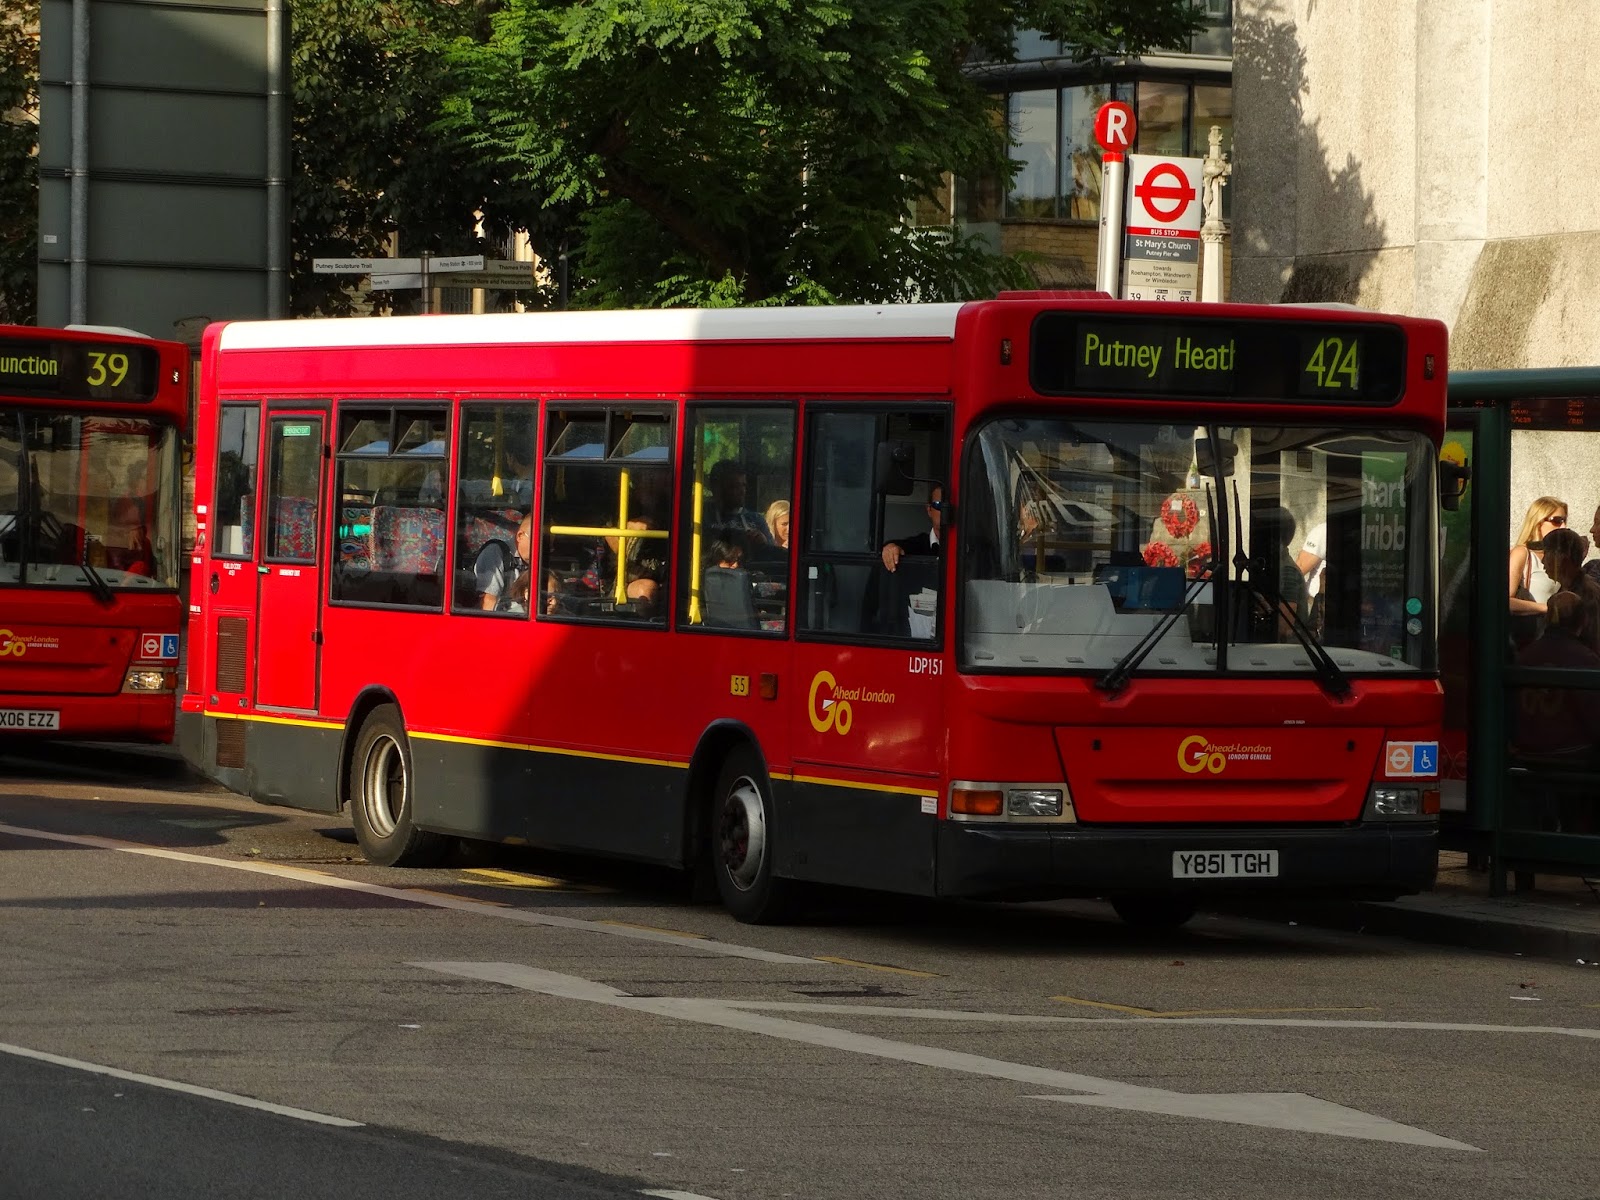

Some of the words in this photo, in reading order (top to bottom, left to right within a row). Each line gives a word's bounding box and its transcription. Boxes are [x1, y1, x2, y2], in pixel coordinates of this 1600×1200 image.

[1106, 107, 1128, 145] R
[1164, 229, 1180, 237] STOP
[1135, 239, 1143, 247] St
[1144, 239, 1167, 250] Mary's
[1167, 241, 1192, 251] Church
[1163, 271, 1192, 279] Wandsworth
[1084, 333, 1162, 378] Putney
[1305, 336, 1359, 389] 424
[86, 351, 129, 387] 39
[908, 656, 943, 676] LDP151
[733, 676, 745, 693] 55
[808, 670, 853, 736] Go
[832, 685, 860, 701] Ahead
[861, 686, 895, 704] London
[28, 712, 55, 728] EZZ
[1177, 734, 1226, 775] Go
[1204, 743, 1272, 753] Ahead-London
[1228, 753, 1249, 761] LONDON
[1249, 753, 1272, 761] GENERAL
[1179, 853, 1225, 875] Y851
[1230, 853, 1271, 875] TGH
